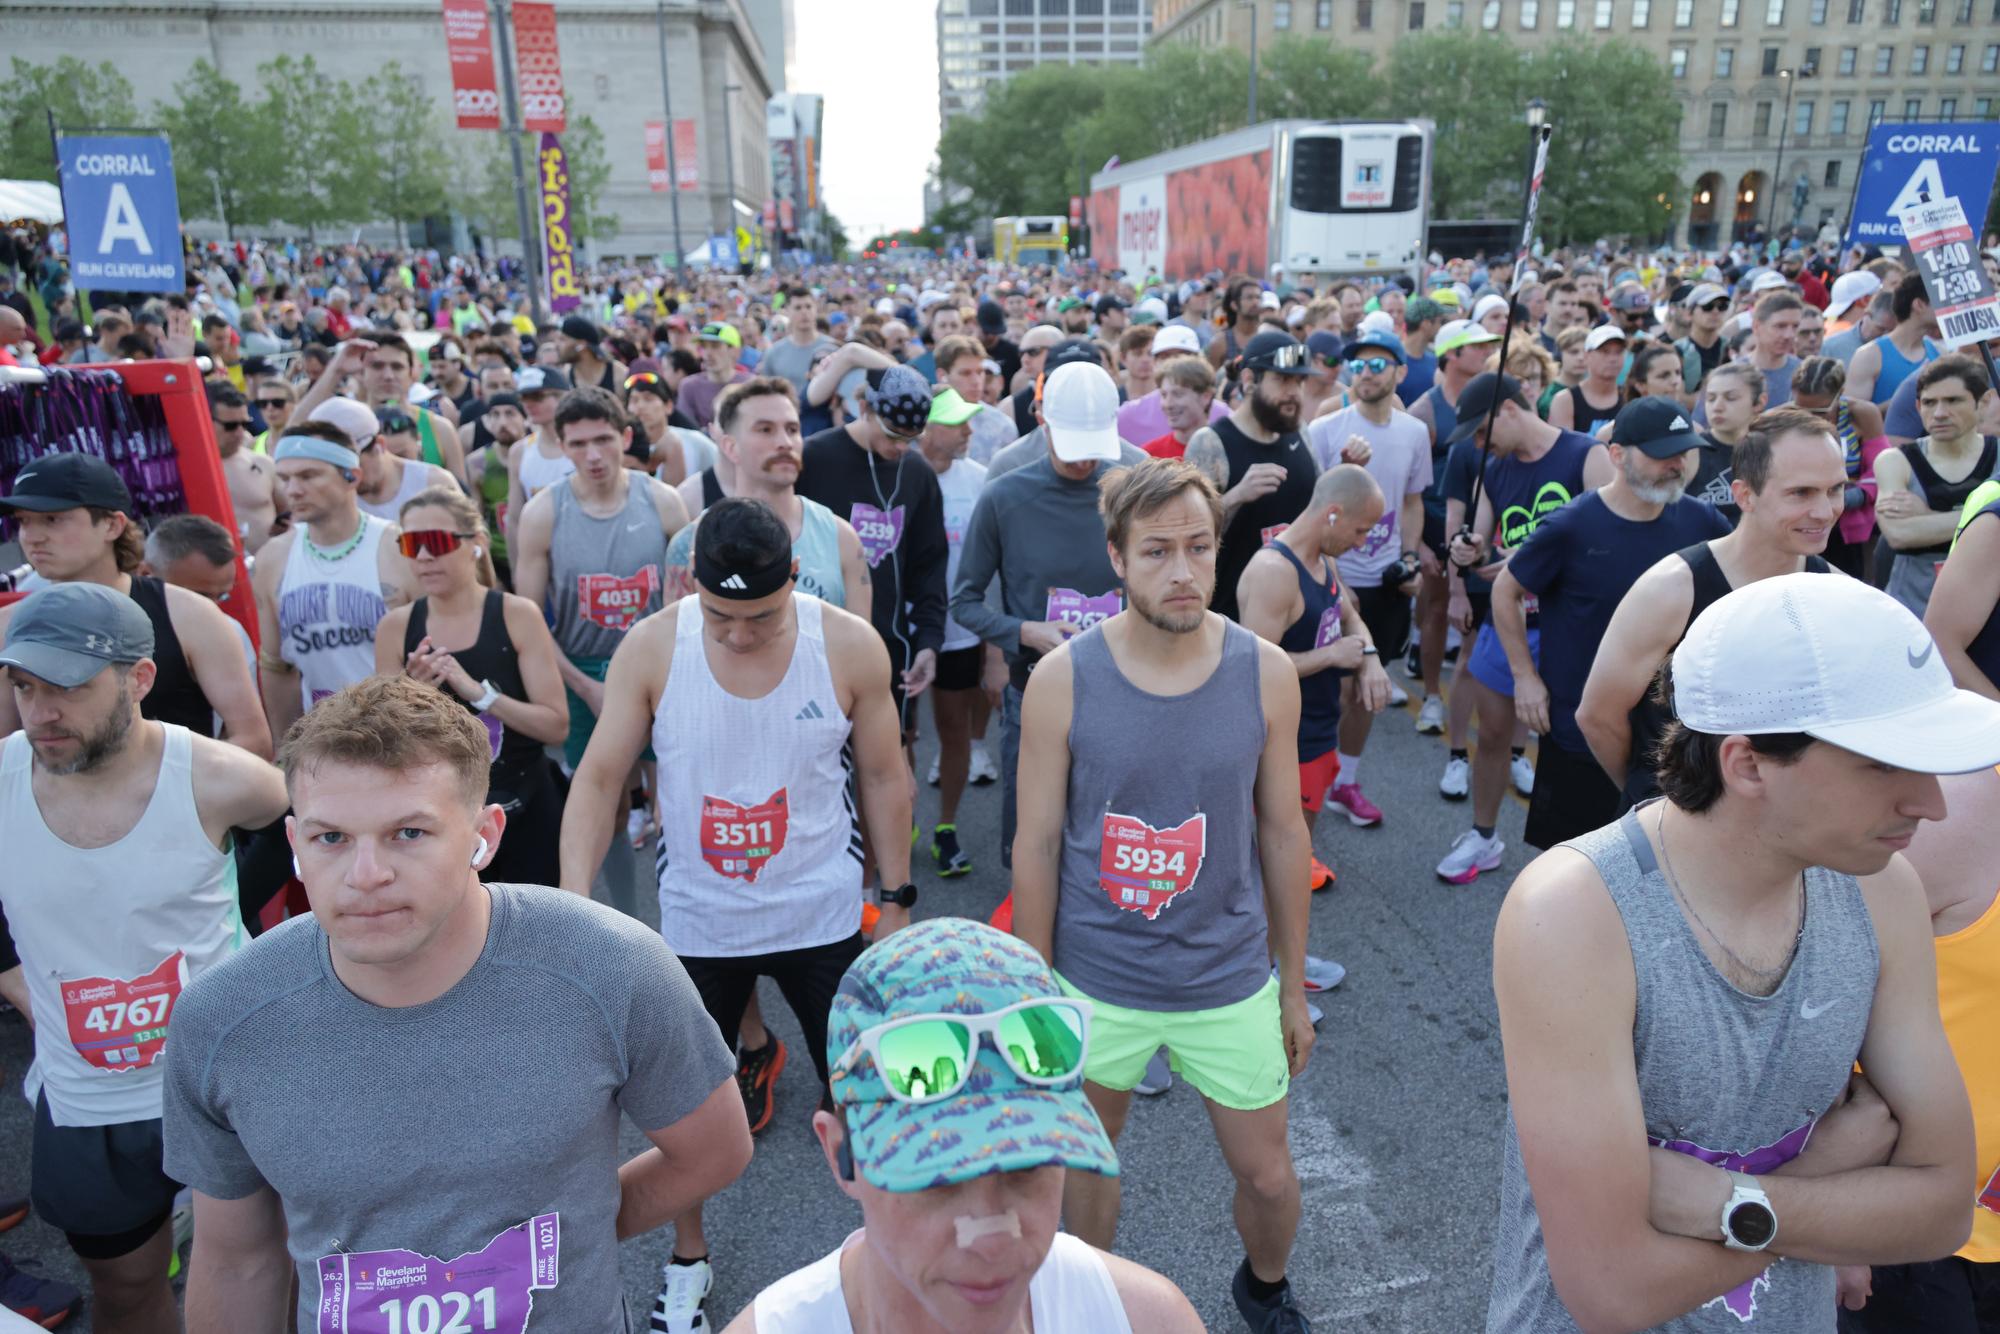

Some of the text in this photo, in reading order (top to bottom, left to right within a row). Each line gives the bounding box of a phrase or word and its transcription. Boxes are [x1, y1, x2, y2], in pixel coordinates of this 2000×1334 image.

[519, 51, 560, 71] 200
[521, 72, 562, 92] 200
[456, 88, 499, 111] 200
[524, 93, 565, 114] 200
[1887, 134, 1981, 153] CORRAL
[76, 154, 156, 176] CORRAL
[1886, 158, 1947, 217] A
[98, 182, 154, 255] A
[1922, 204, 1958, 218] Cleveland
[1123, 200, 1161, 265] meijer
[1858, 222, 1888, 236] RUN
[1922, 242, 1971, 273] 1:40
[77, 262, 176, 279] RUN CLEVELAND
[1931, 269, 1982, 302] 7:38
[1943, 307, 2000, 339] MUSH
[858, 520, 896, 540] 2539
[597, 588, 641, 607] 4031
[291, 624, 376, 654] Soccer
[713, 820, 773, 846] 3511
[747, 848, 766, 858] 13.1
[1113, 844, 1187, 876] 5934
[1151, 880, 1170, 891] 13.1
[80, 983, 116, 996] Cleveland
[80, 989, 116, 1001] Marathon
[85, 992, 171, 1033] 4767
[136, 1028, 160, 1043] 13.1
[540, 1221, 554, 1250] 1021
[323, 1272, 343, 1281] 26.2
[376, 1263, 426, 1278] Cleveland
[538, 1258, 546, 1278] FREE
[547, 1254, 555, 1281] DRINK
[376, 1274, 427, 1287] Marathon
[322, 1297, 332, 1313] TAG
[331, 1282, 342, 1330] GEAR CHECK
[379, 1286, 497, 1334] 1021
